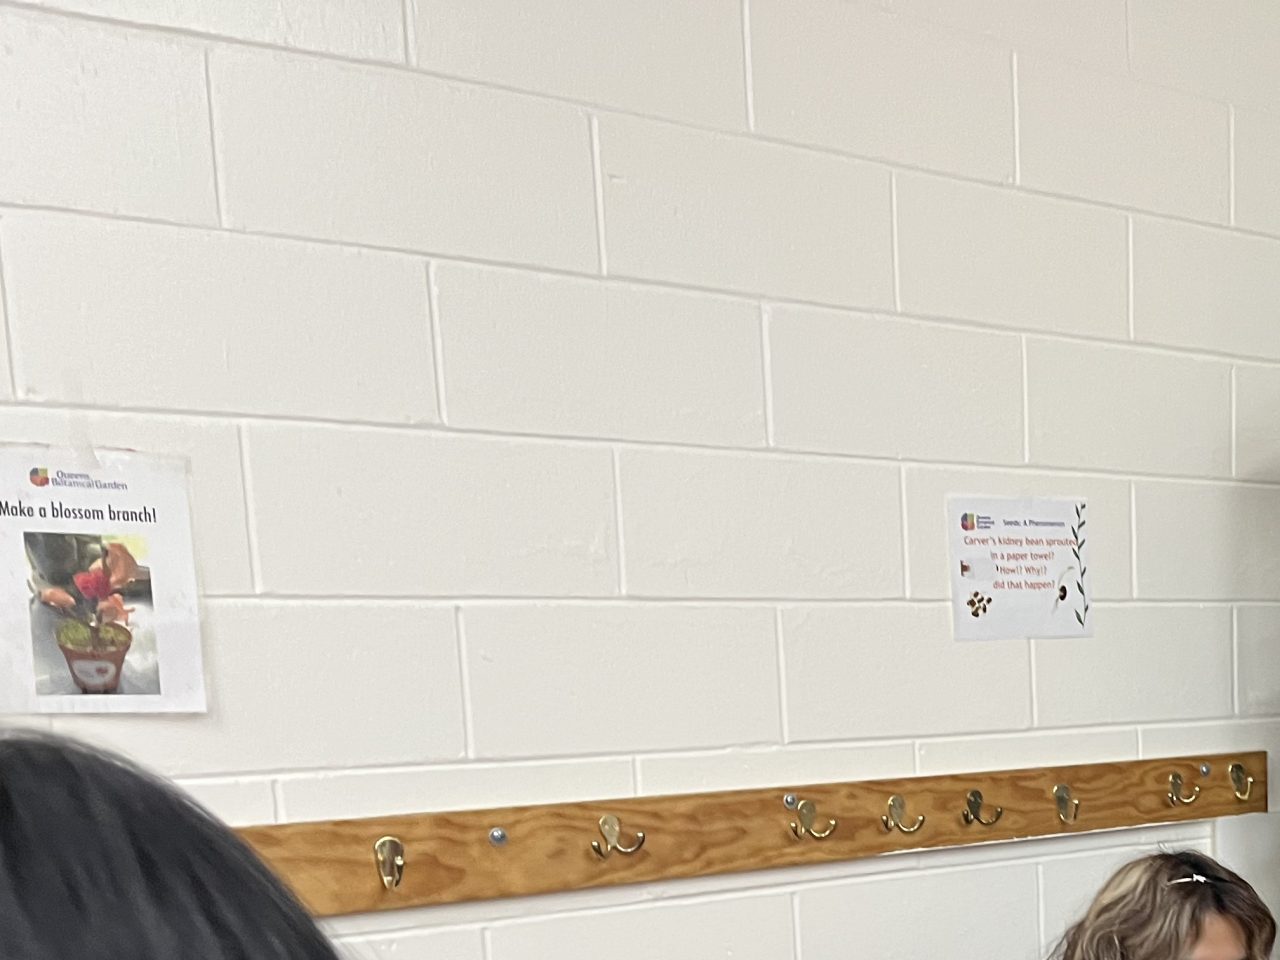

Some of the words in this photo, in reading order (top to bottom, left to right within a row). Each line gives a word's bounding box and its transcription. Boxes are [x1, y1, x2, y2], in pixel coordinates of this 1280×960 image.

[95, 480, 128, 490] Garden
[0, 500, 34, 517] Make
[39, 507, 47, 518] a
[51, 501, 104, 520] blossom
[108, 504, 157, 523] branch!
[998, 536, 1022, 547] kidney
[1025, 536, 1044, 546] bean
[1006, 552, 1028, 562] paper
[992, 580, 1005, 589] did
[1007, 580, 1023, 589] that
